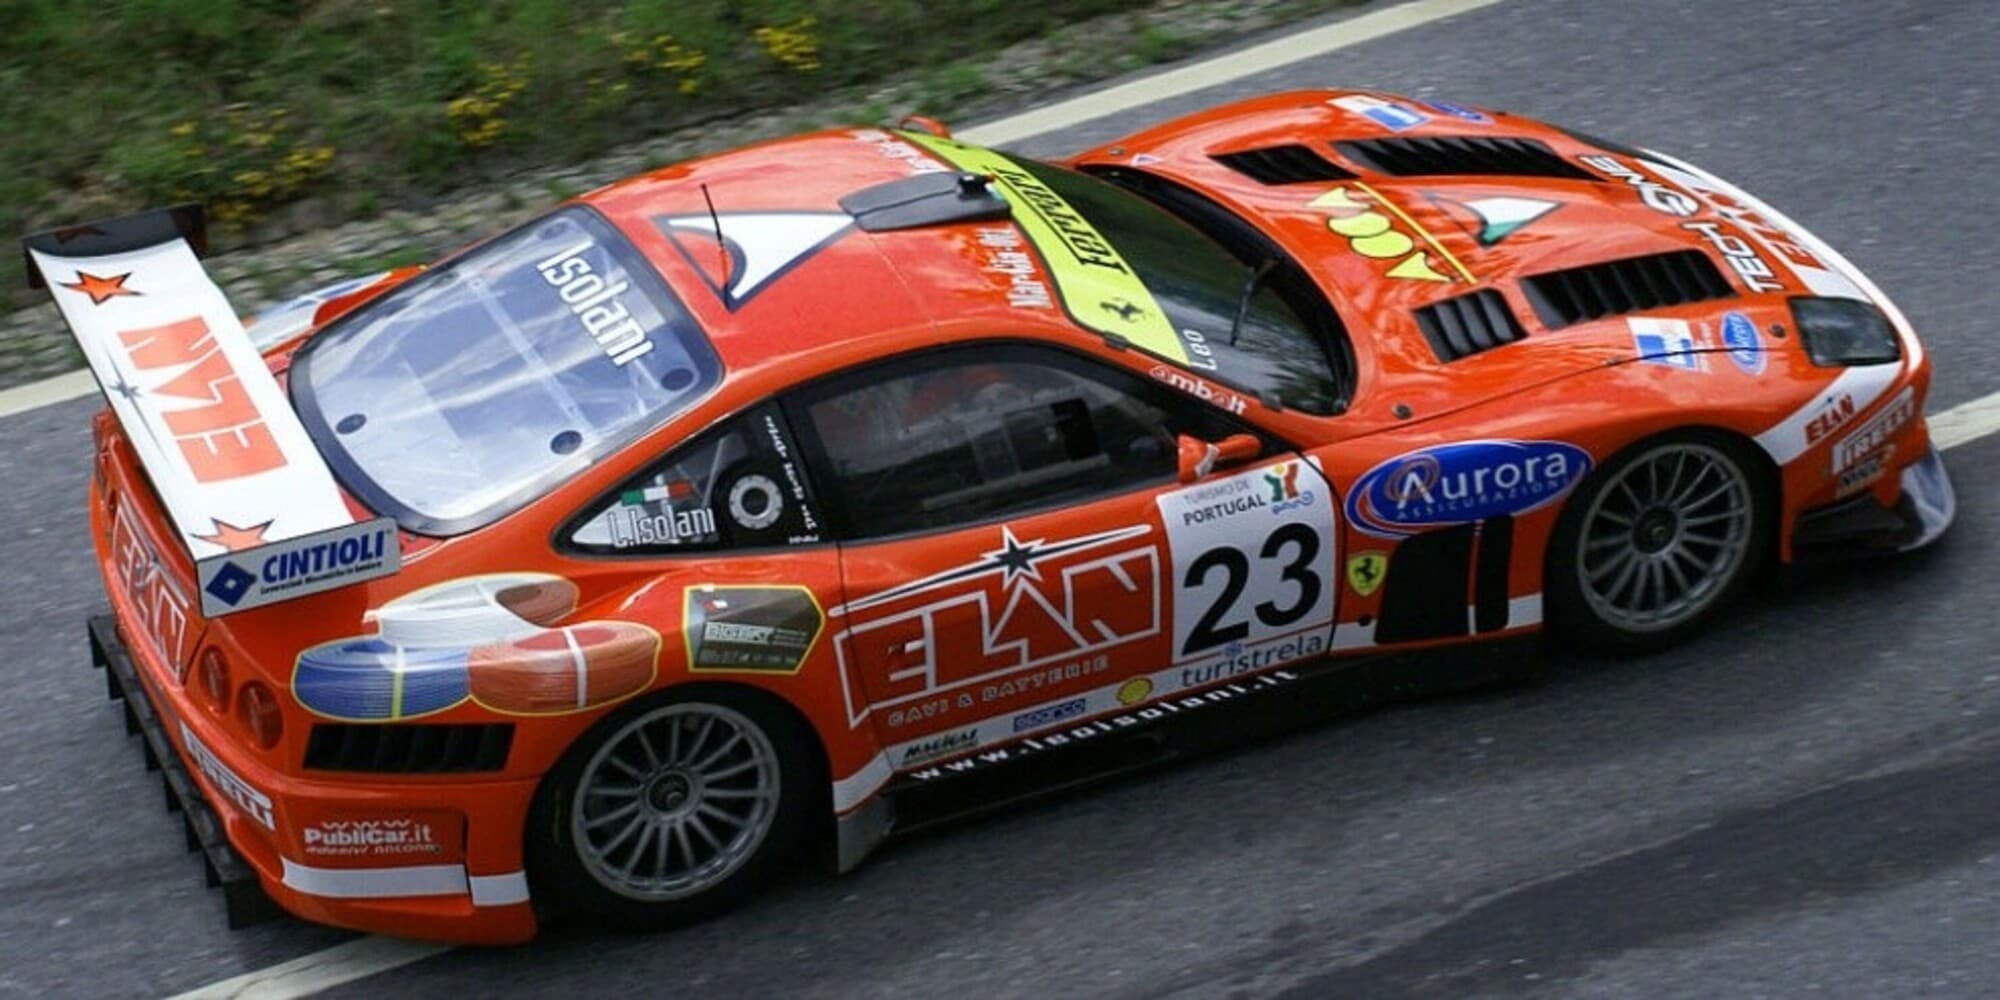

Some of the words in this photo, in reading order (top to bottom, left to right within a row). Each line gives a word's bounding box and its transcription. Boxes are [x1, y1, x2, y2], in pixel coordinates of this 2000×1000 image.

[990, 167, 1129, 275] Ferrari
[1682, 222, 1785, 293] TECH
[536, 239, 654, 367] Isolani
[1182, 328, 1217, 370] Leo
[116, 316, 288, 484] ELAN
[1805, 394, 1854, 445] ELAN
[1183, 493, 1268, 526] PORTUGAL
[1397, 452, 1569, 510] Aurora
[607, 507, 717, 549] L.Isolani
[262, 530, 384, 585] CINTIOLI
[1182, 522, 1322, 657] 23
[834, 545, 1161, 729] ELAN
[1181, 634, 1323, 688] turistrela
[888, 699, 950, 728] CAVI
[958, 693, 973, 708] &
[983, 655, 1109, 703] BATTERIE
[304, 824, 432, 846] PubliCar.it
